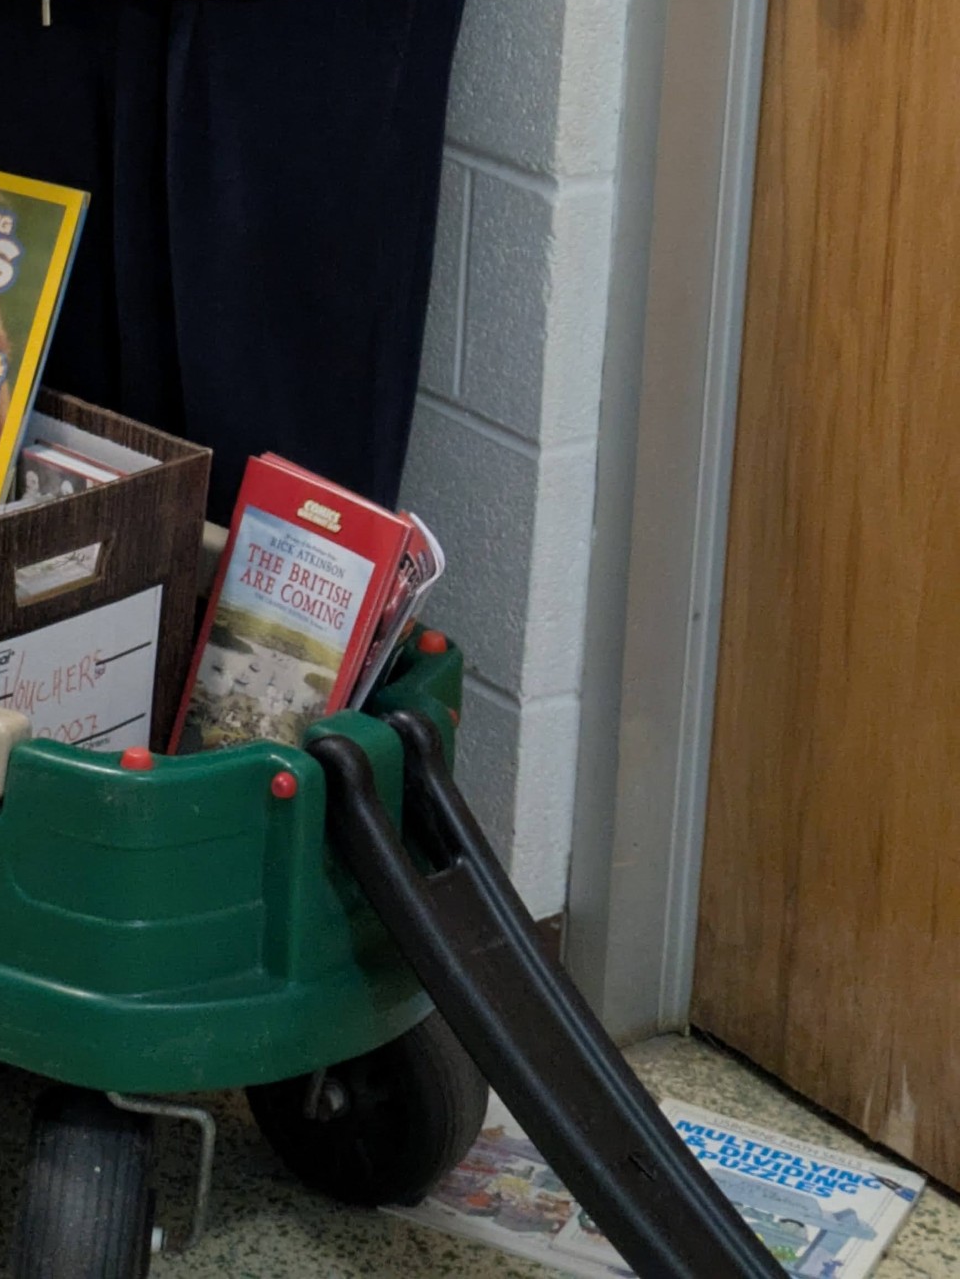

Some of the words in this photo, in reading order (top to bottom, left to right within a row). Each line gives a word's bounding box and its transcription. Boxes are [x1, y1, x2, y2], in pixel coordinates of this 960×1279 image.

[248, 542, 285, 576] THE
[288, 561, 353, 611] BRITISH
[297, 547, 346, 580] ATKINSON
[239, 566, 276, 596] ARE
[280, 583, 346, 631] COMING
[675, 1119, 882, 1191] MULTIPLYING
[683, 1134, 706, 1149] &
[719, 1142, 861, 1196] DIVIDING
[695, 1149, 833, 1199] PUZZLES
